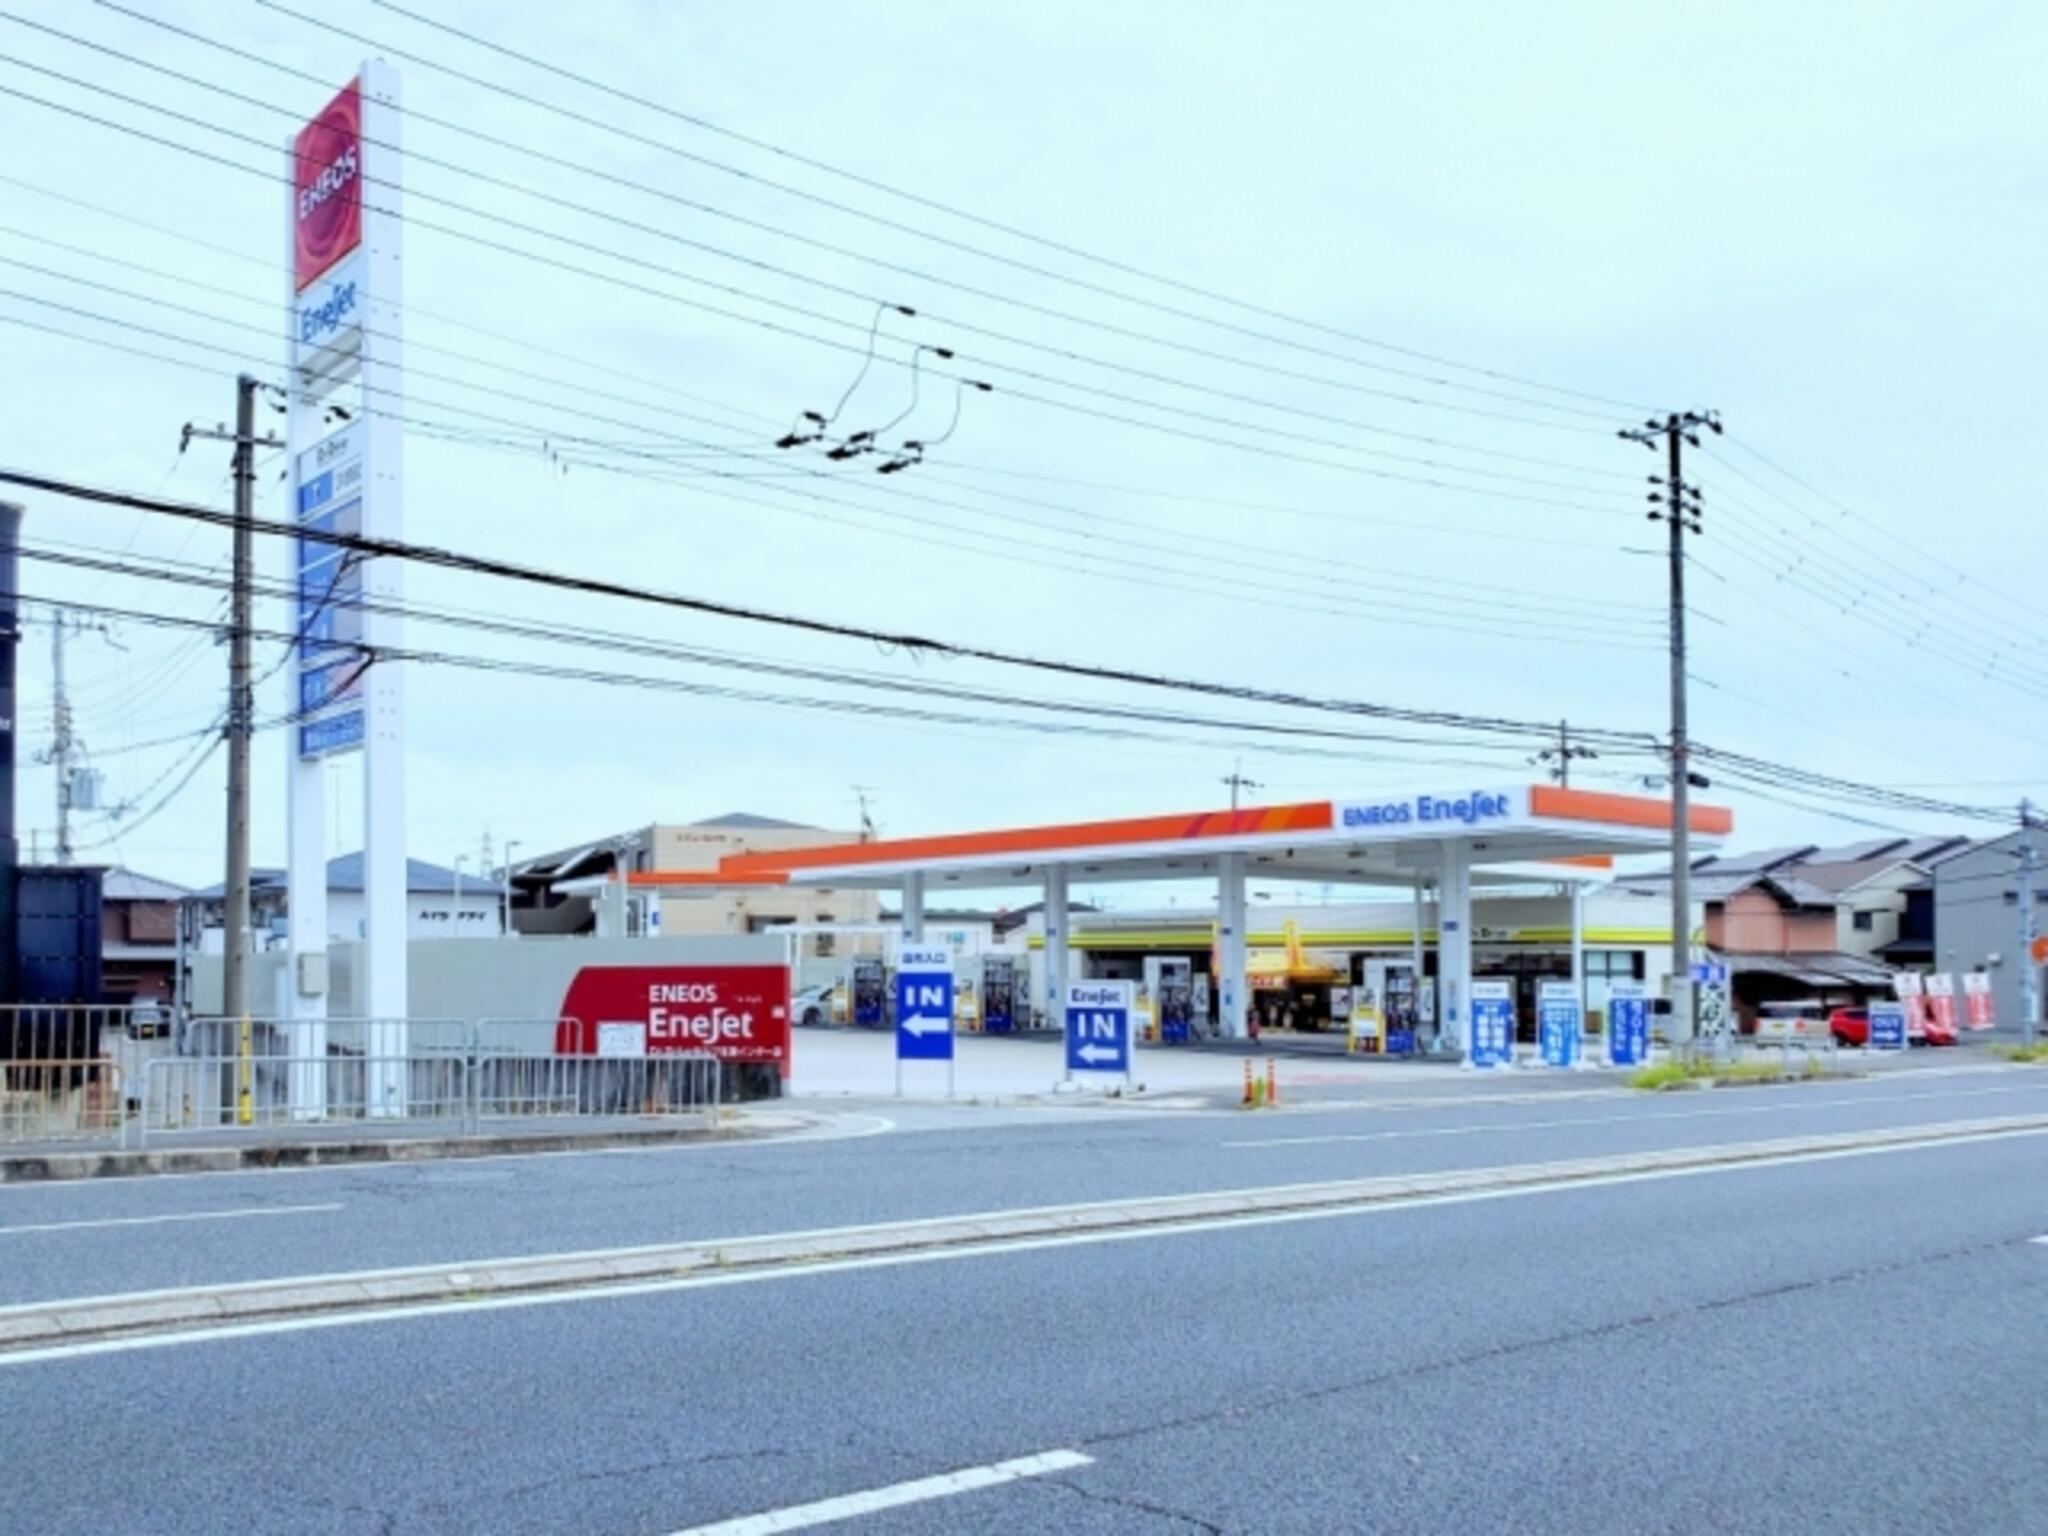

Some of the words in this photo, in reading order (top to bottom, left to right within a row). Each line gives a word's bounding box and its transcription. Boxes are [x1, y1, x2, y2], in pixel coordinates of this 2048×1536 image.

[300, 147, 357, 221] ENEOS
[1343, 802, 1411, 826] ENEOS
[649, 984, 718, 1003] ENEOS
[905, 986, 944, 1006] IN
[1077, 1014, 1115, 1038] IN
